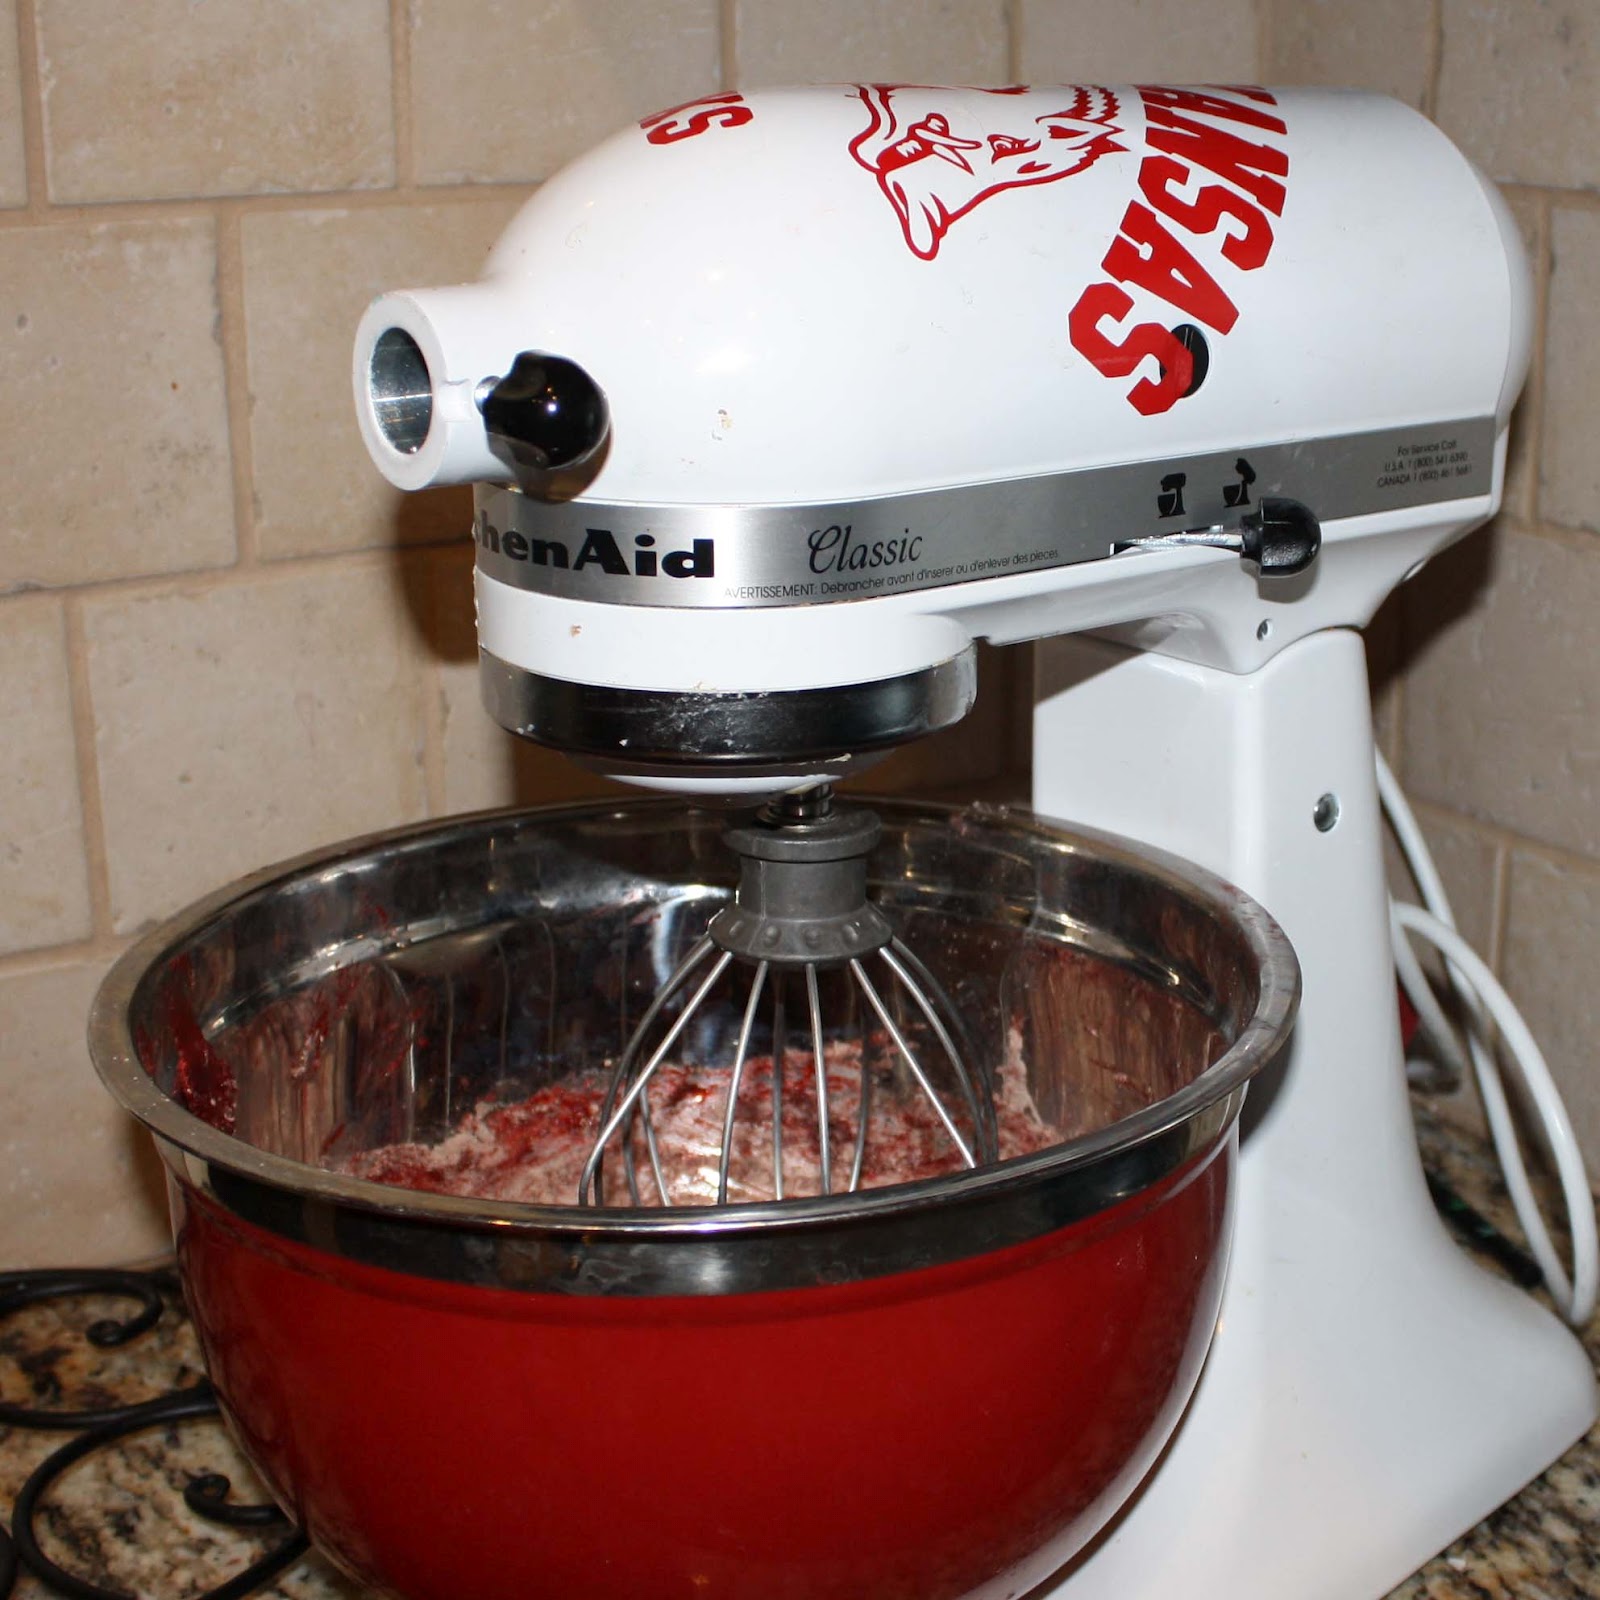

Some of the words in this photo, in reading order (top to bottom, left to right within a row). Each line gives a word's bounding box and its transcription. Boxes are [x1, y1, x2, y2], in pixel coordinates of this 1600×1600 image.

[1411, 443, 1440, 455] Service
[1377, 473, 1410, 488] CANADA
[474, 509, 714, 579] henAid
[808, 525, 922, 574] Classic
[888, 572, 914, 586] avant
[956, 563, 968, 574] ou
[1013, 552, 1028, 565] des
